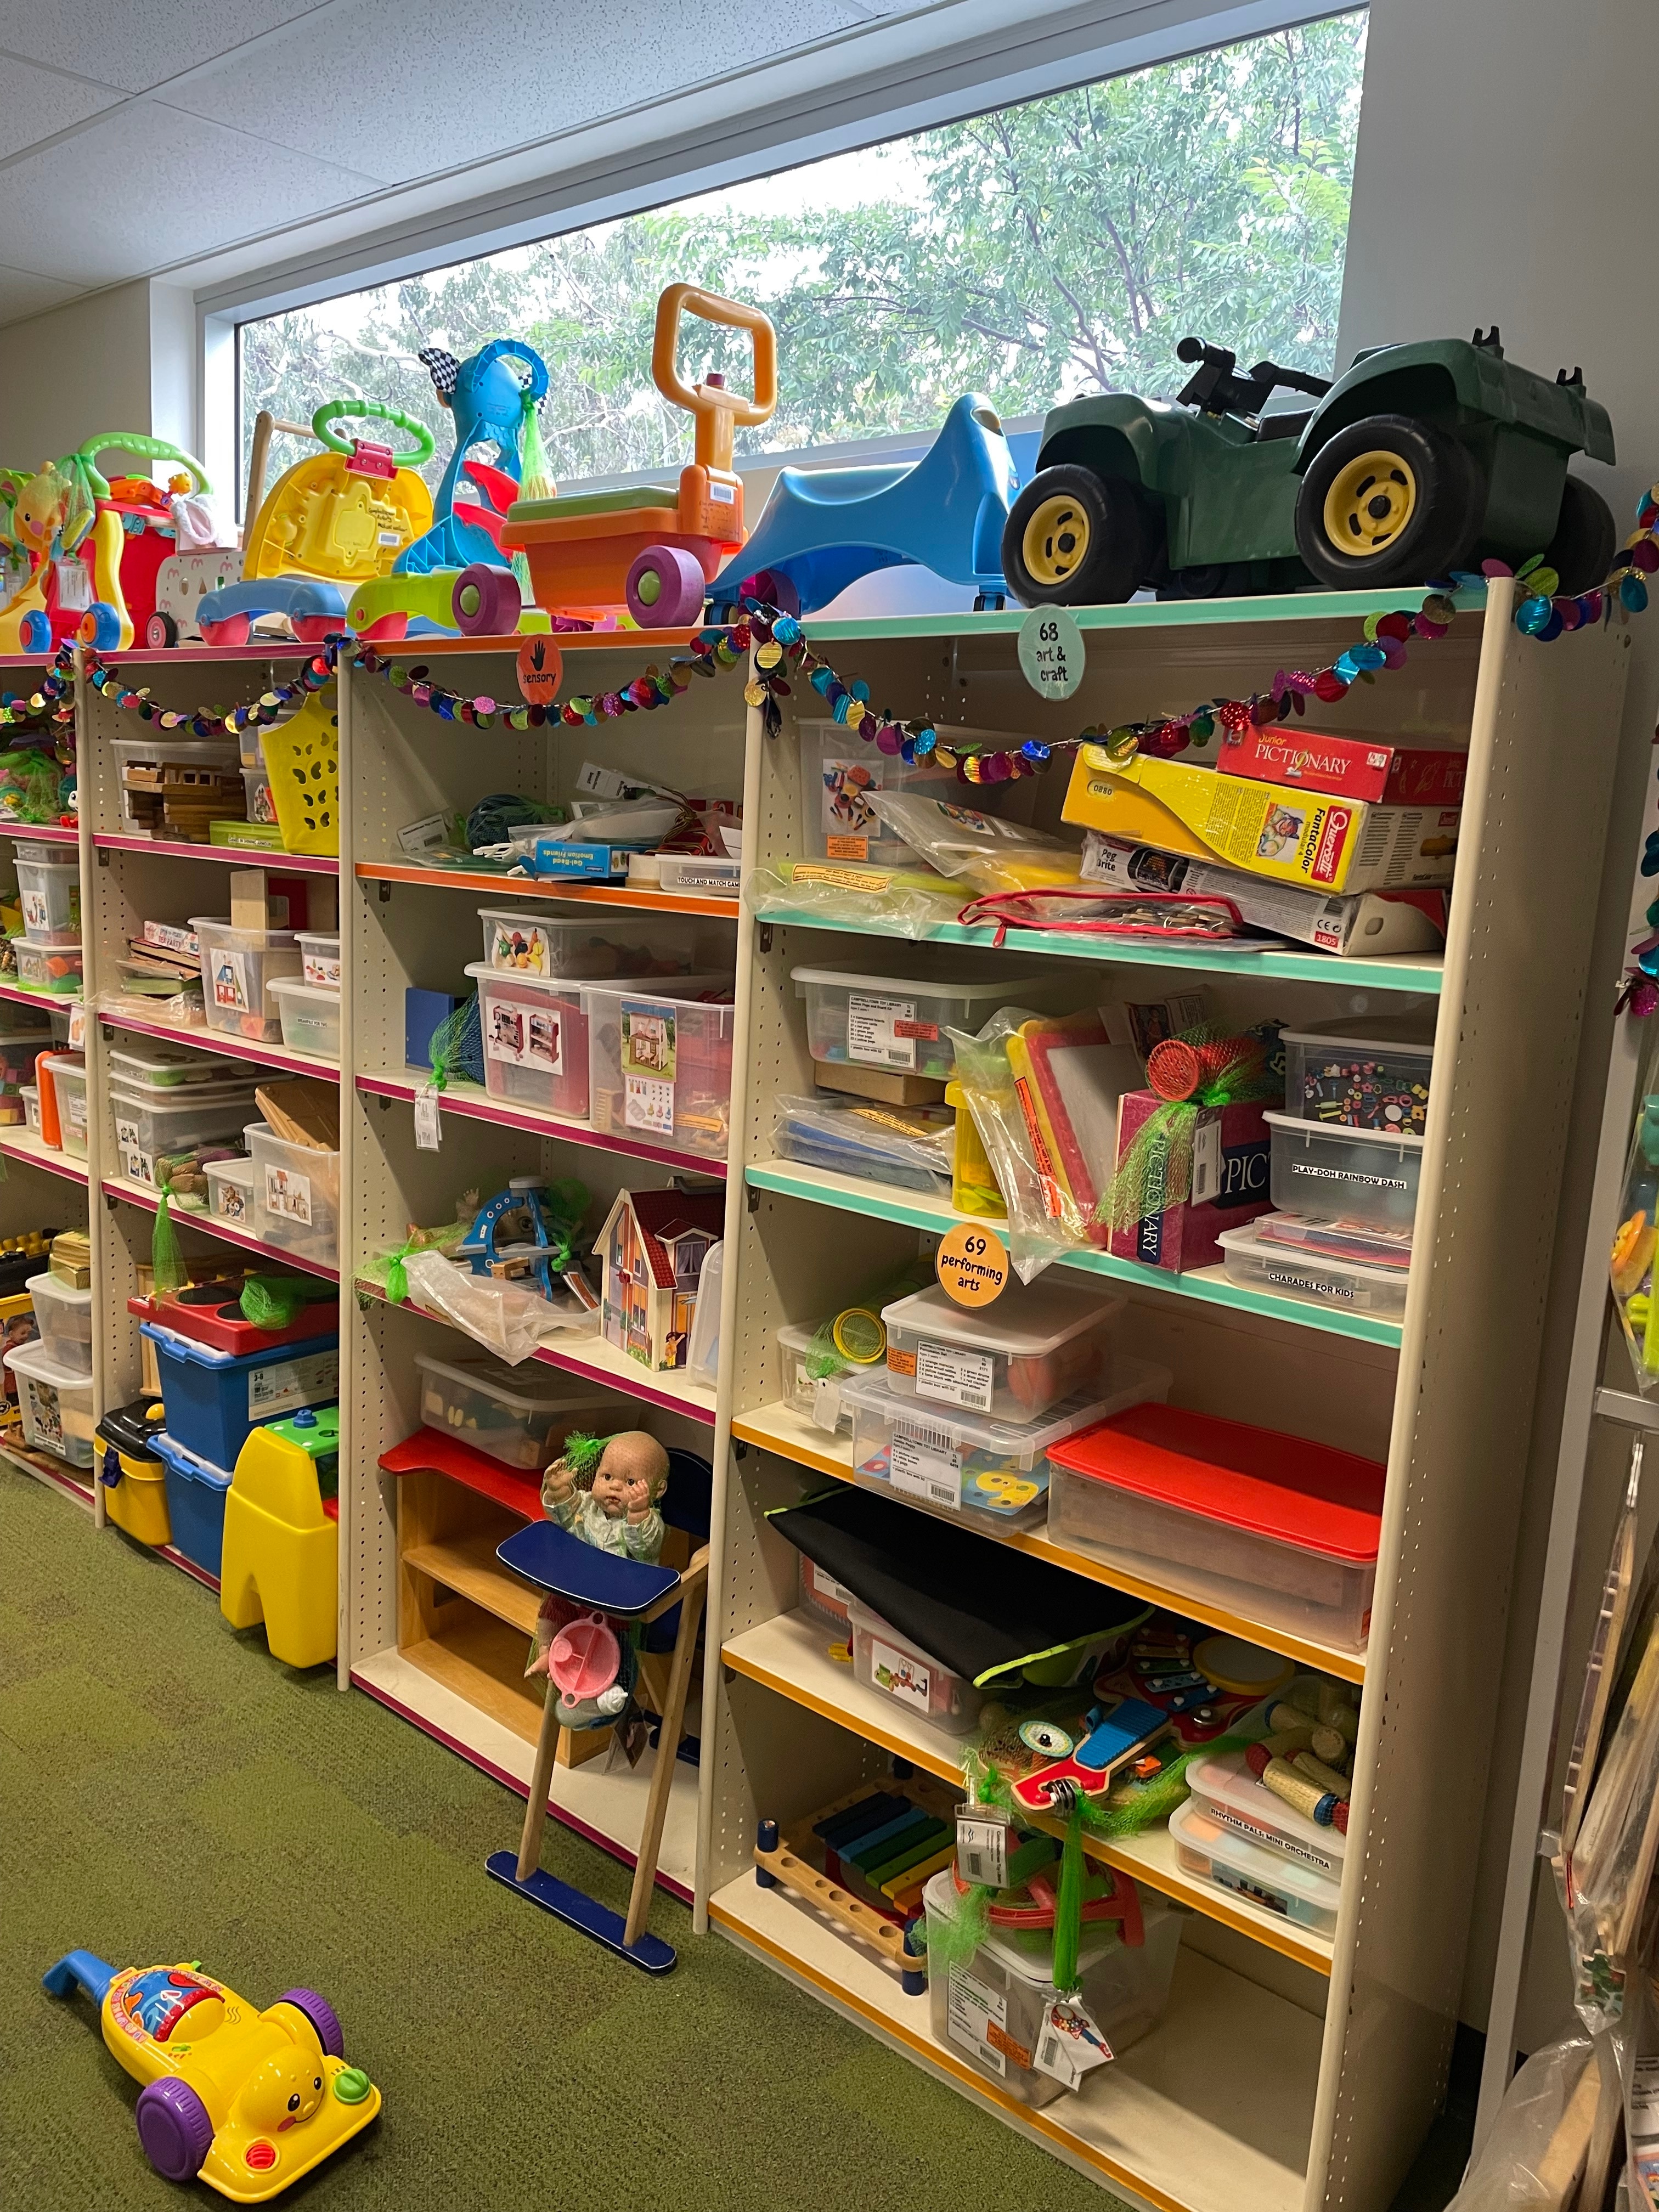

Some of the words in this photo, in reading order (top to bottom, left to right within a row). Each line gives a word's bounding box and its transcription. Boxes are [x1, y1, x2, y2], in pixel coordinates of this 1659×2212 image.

[1040, 622, 1058, 641] 68
[1036, 647, 1054, 662] art
[1057, 646, 1066, 662] &
[523, 673, 556, 686] sensory
[1040, 665, 1068, 681] craft
[1259, 733, 1286, 746] Junior
[1255, 743, 1351, 775] PICTIONARY
[1093, 785, 1113, 796] 0880
[1300, 821, 1311, 850] modular
[1301, 808, 1326, 874] FantaColor
[1316, 811, 1348, 878] Quercetti
[1096, 858, 1116, 871] Brite
[1102, 848, 1117, 862] Peg
[1316, 934, 1337, 946] 1805
[1224, 1153, 1270, 1194] PIC
[1292, 1165, 1336, 1178] PLAY-DOH
[1338, 1172, 1379, 1185] RAINBOW
[1381, 1179, 1404, 1189] DASH
[1143, 1139, 1166, 1256] PICTIONARY
[965, 1236, 986, 1255] 69
[941, 1255, 1003, 1285] performing
[957, 1277, 980, 1291] arts
[1269, 1273, 1313, 1289] CHARADES
[1316, 1283, 1333, 1294] FOR
[1335, 1288, 1354, 1299] KIDS
[1211, 1808, 1242, 1827] RHYTHM
[1266, 1833, 1283, 1847] MINI
[1285, 1842, 1330, 1870] ORCHESTRA
